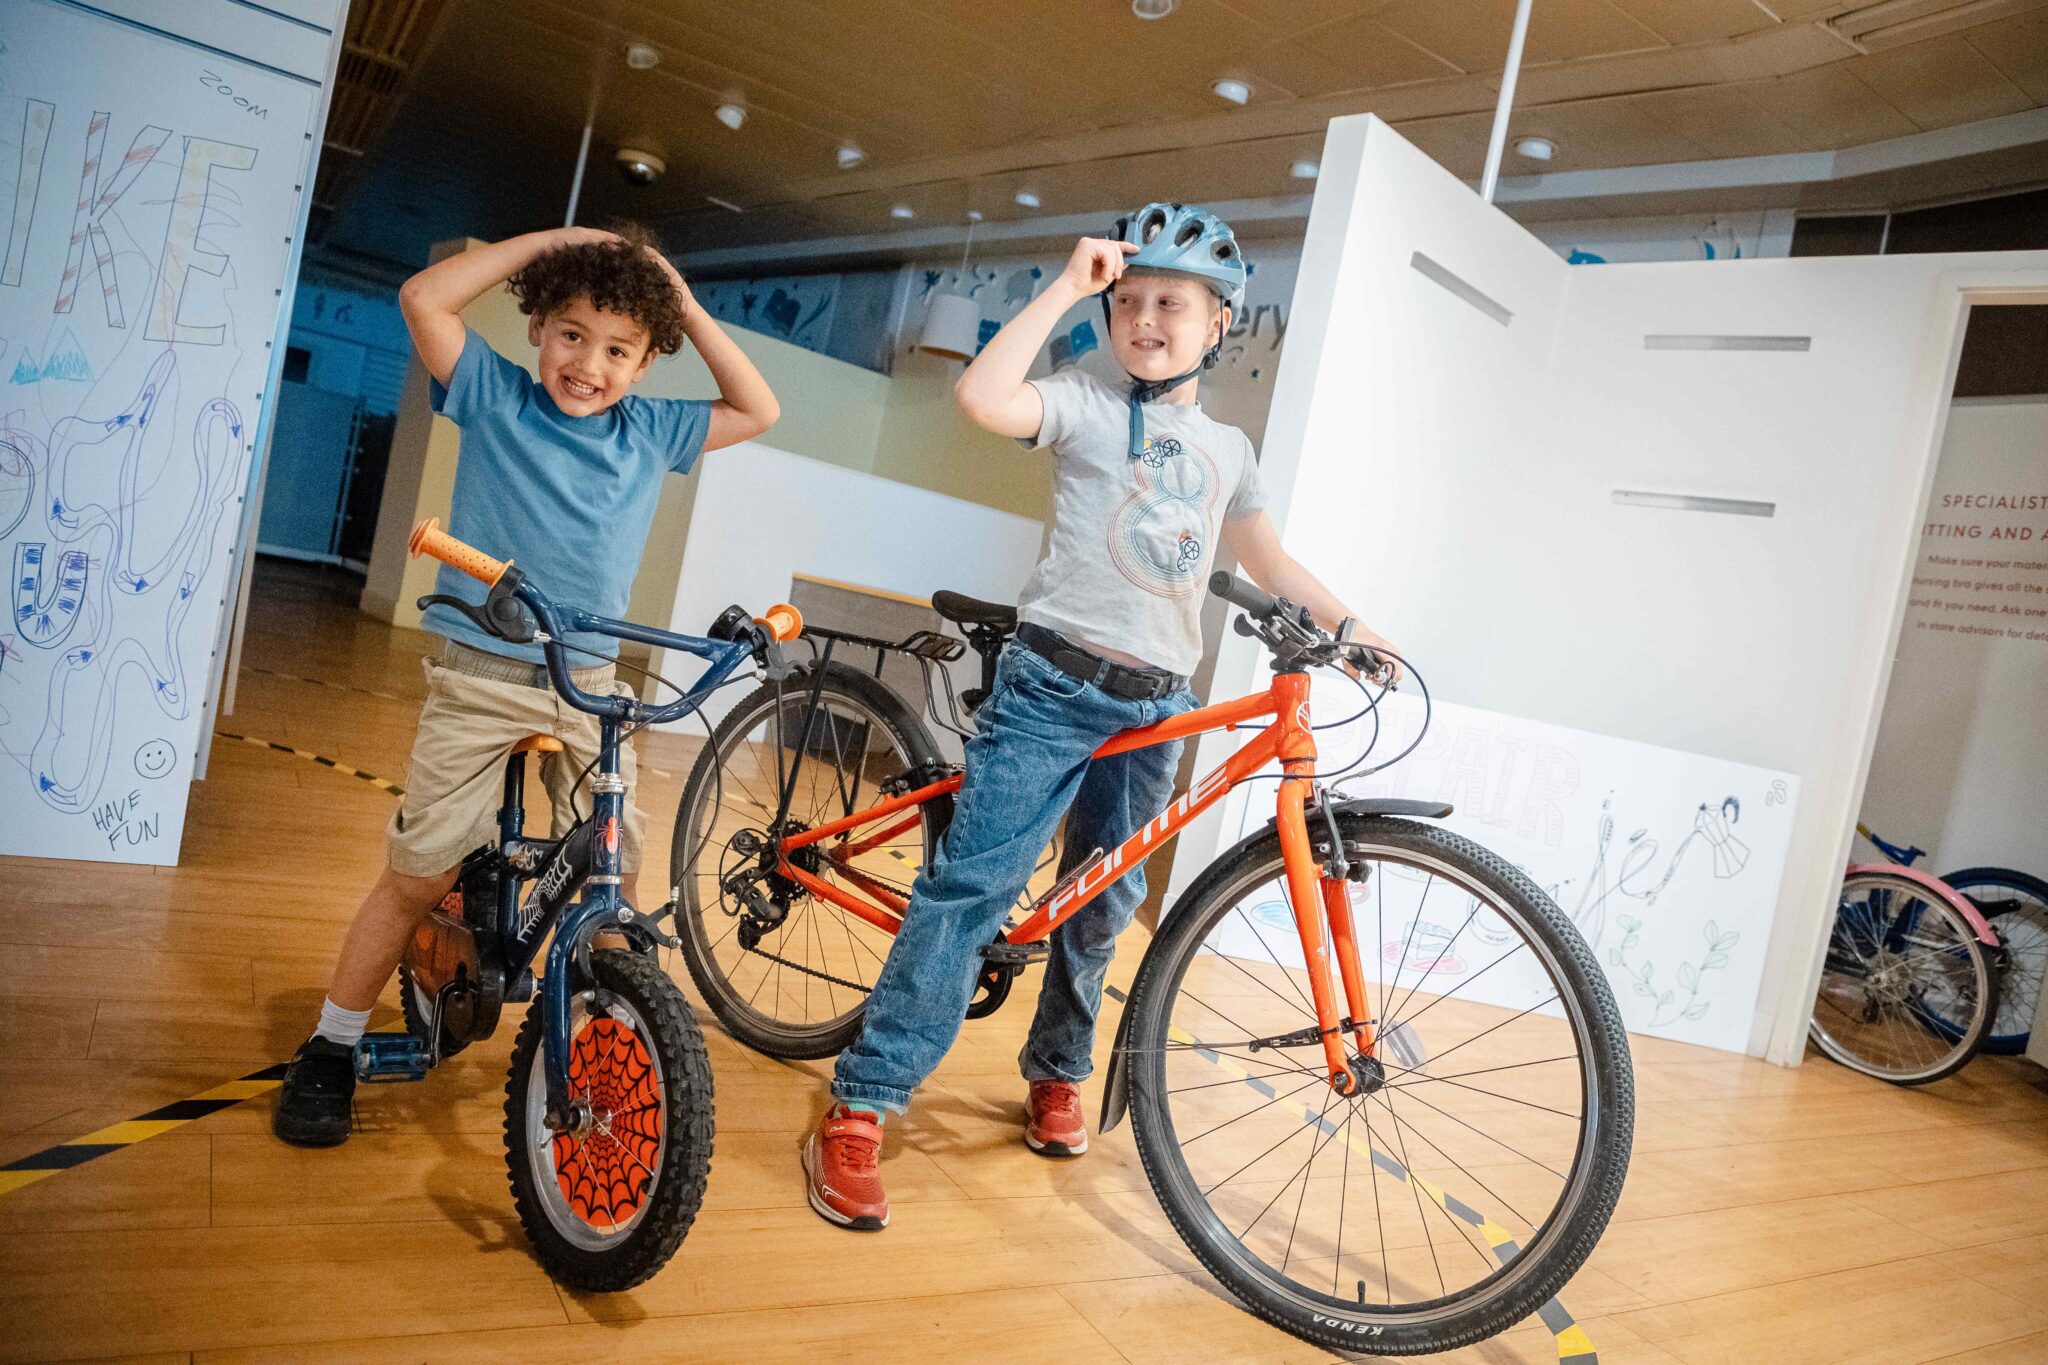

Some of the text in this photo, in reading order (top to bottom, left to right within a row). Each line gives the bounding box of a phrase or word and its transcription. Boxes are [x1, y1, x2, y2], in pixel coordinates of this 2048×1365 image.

[199, 69, 269, 121] ZOOM
[1990, 525, 2033, 541] AND
[1928, 555, 1958, 565] Make
[1961, 558, 1983, 567] sure
[1986, 559, 2011, 570] your
[1952, 579, 1972, 589] bra
[1974, 581, 2003, 593] gives
[2006, 582, 2021, 592] all
[2024, 583, 2042, 594] the
[1944, 602, 1964, 611] you
[2000, 604, 2020, 615] Ask
[2024, 607, 2047, 618] one
[1918, 621, 1926, 629] in
[1930, 622, 1955, 632] store
[1958, 624, 2003, 637] advisors
[2007, 628, 2022, 639] for
[92, 788, 142, 831] HAVE
[107, 812, 160, 852] FUN
[1312, 1313, 1385, 1336] KENDA
